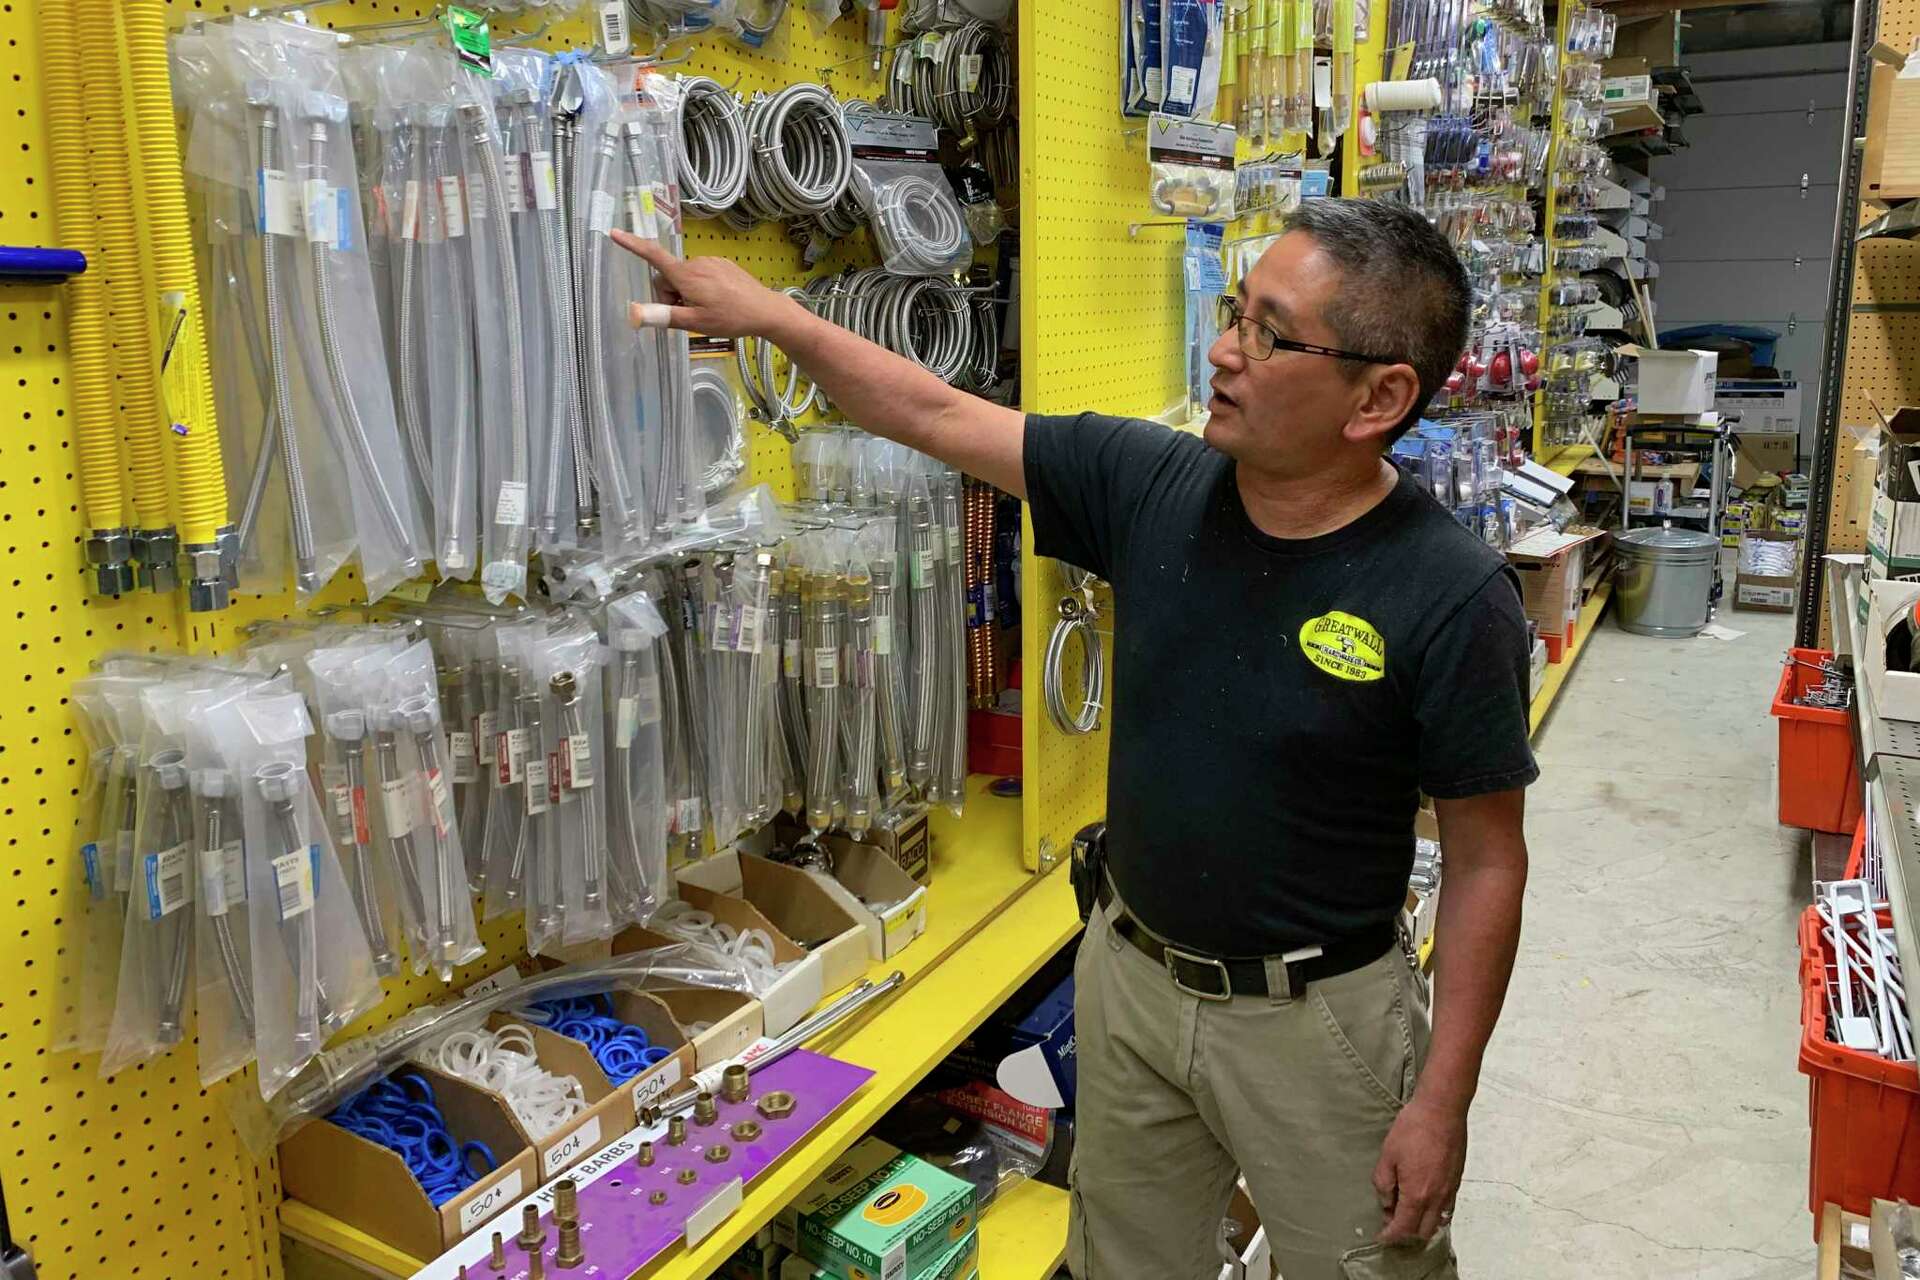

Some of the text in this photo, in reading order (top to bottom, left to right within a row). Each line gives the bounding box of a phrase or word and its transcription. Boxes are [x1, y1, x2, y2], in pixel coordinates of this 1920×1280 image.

[1314, 618, 1383, 656] GREATWALL
[1313, 654, 1367, 679] SINCE 1983
[580, 1141, 634, 1175] BARBS
[912, 1213, 947, 1246] NO-SEEP
[963, 1195, 971, 1205] 10
[804, 1221, 873, 1267] NO-SEEP NO. 10
